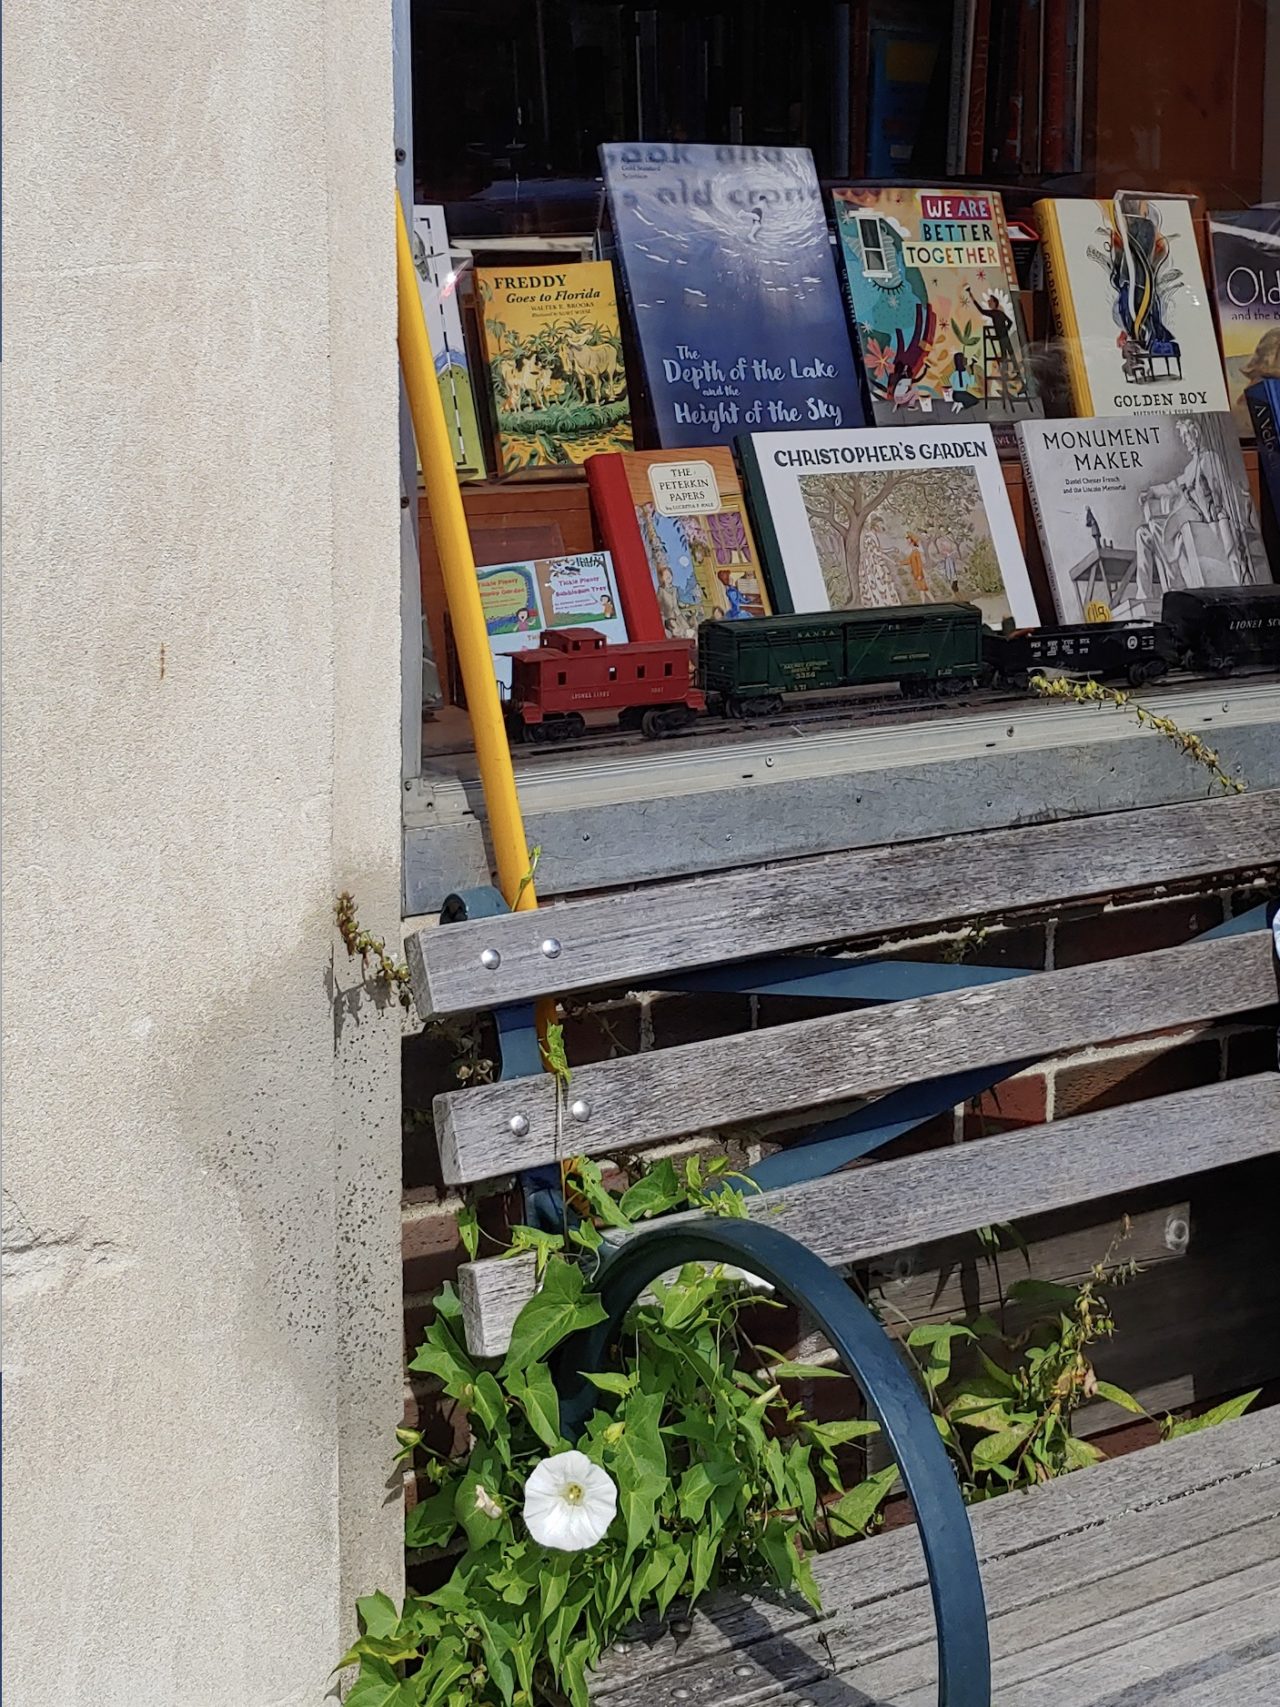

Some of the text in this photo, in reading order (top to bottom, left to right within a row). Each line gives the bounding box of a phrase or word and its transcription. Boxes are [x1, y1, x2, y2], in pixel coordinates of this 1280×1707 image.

[926, 199, 989, 218] WE ARE
[923, 223, 993, 241] BETTER
[906, 246, 998, 264] TOGETHER
[494, 274, 567, 290] FREDDY
[506, 288, 601, 304] Goes to Florida
[1231, 307, 1251, 320] and
[1254, 307, 1270, 320] the
[676, 345, 700, 360] The
[662, 357, 839, 390] Depth of the Lake
[702, 385, 742, 397] and the
[1114, 391, 1208, 408] GOLDEN BOY
[673, 398, 843, 434] Height of the Sky
[1254, 405, 1267, 418] A
[1042, 426, 1160, 450] MONUMENT
[774, 441, 988, 468] CHRISTOPHER'S GARDEN
[1074, 450, 1144, 471] MAKER
[670, 468, 692, 477] THE
[659, 478, 709, 490] PETERKIN
[1018, 436, 1043, 531] MONUMENT MAKER
[670, 490, 705, 502] PAPERS
[1229, 619, 1262, 630] LIONEL
[797, 630, 834, 638] SANTA
